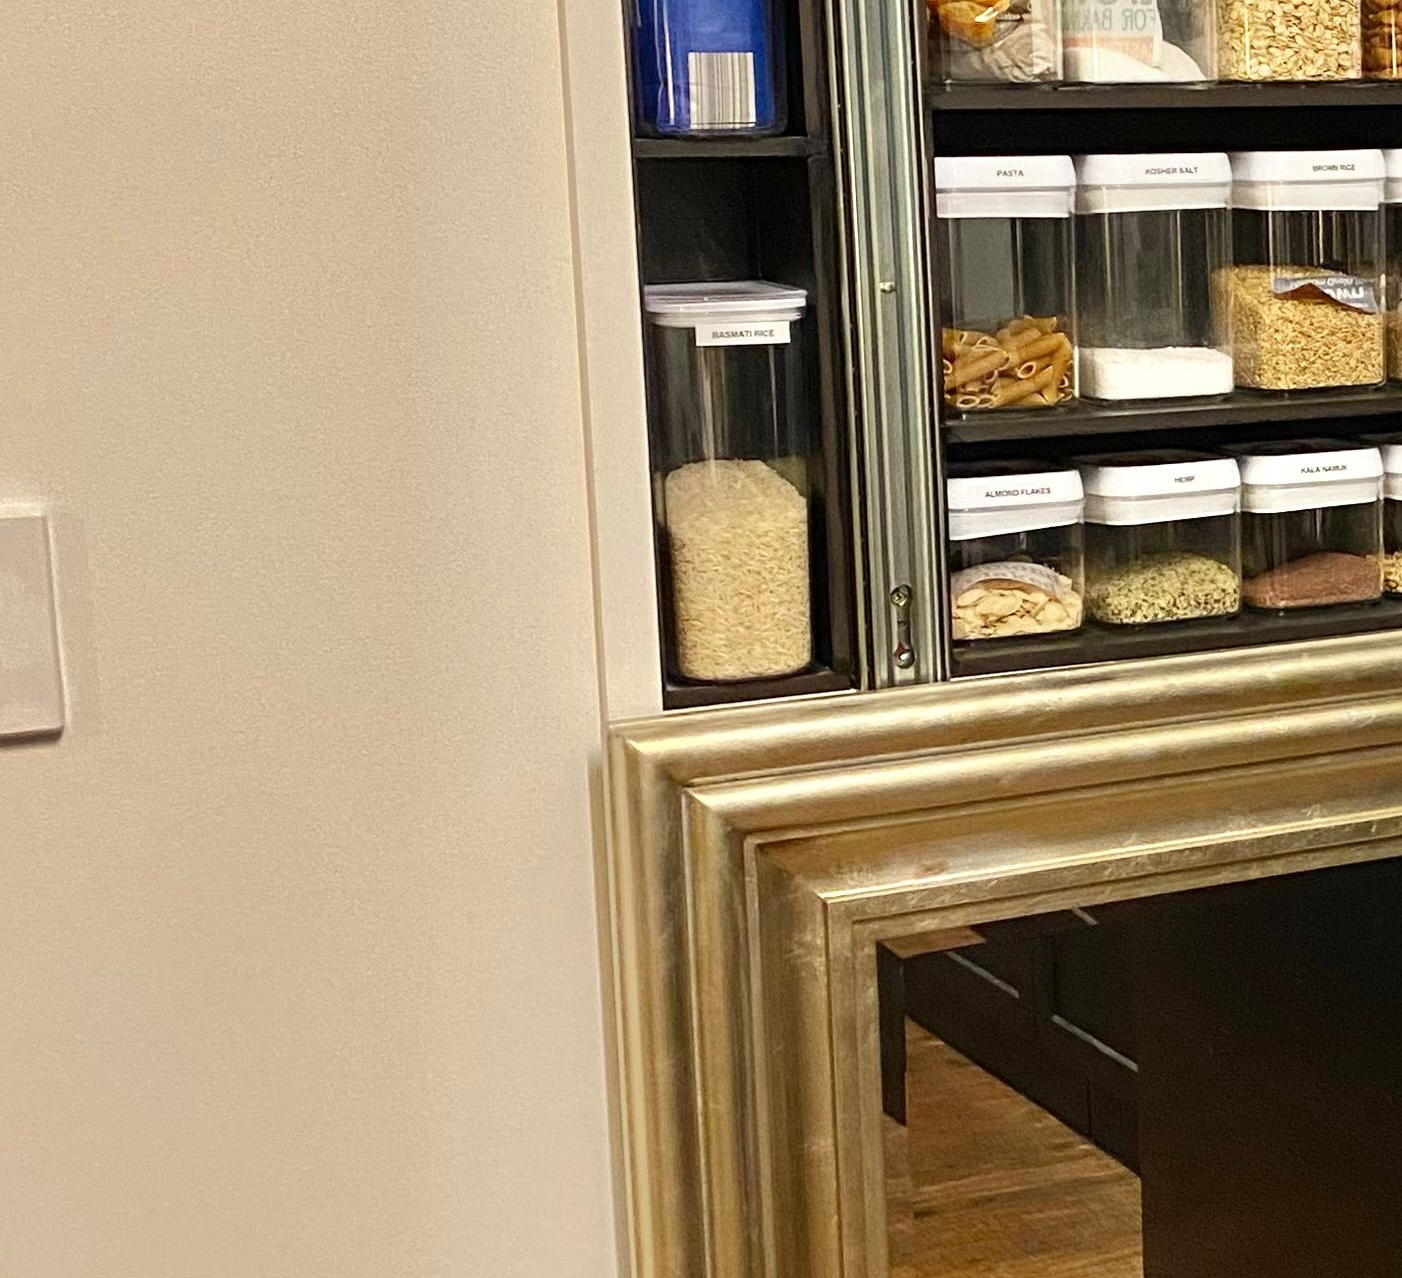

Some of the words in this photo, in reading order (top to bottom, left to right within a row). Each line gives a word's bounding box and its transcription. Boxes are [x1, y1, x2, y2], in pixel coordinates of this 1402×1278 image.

[1145, 167, 1177, 175] KOSHER
[1179, 166, 1198, 174] SALT
[1340, 163, 1356, 171] RICE
[996, 169, 1024, 177] PASTA
[712, 329, 752, 339] BASMATI
[753, 328, 775, 338] RICE
[1301, 466, 1321, 474] KALA
[1174, 475, 1195, 483] HEMP
[985, 489, 1020, 498] ALMOND
[1020, 487, 1051, 495] FLAKES
